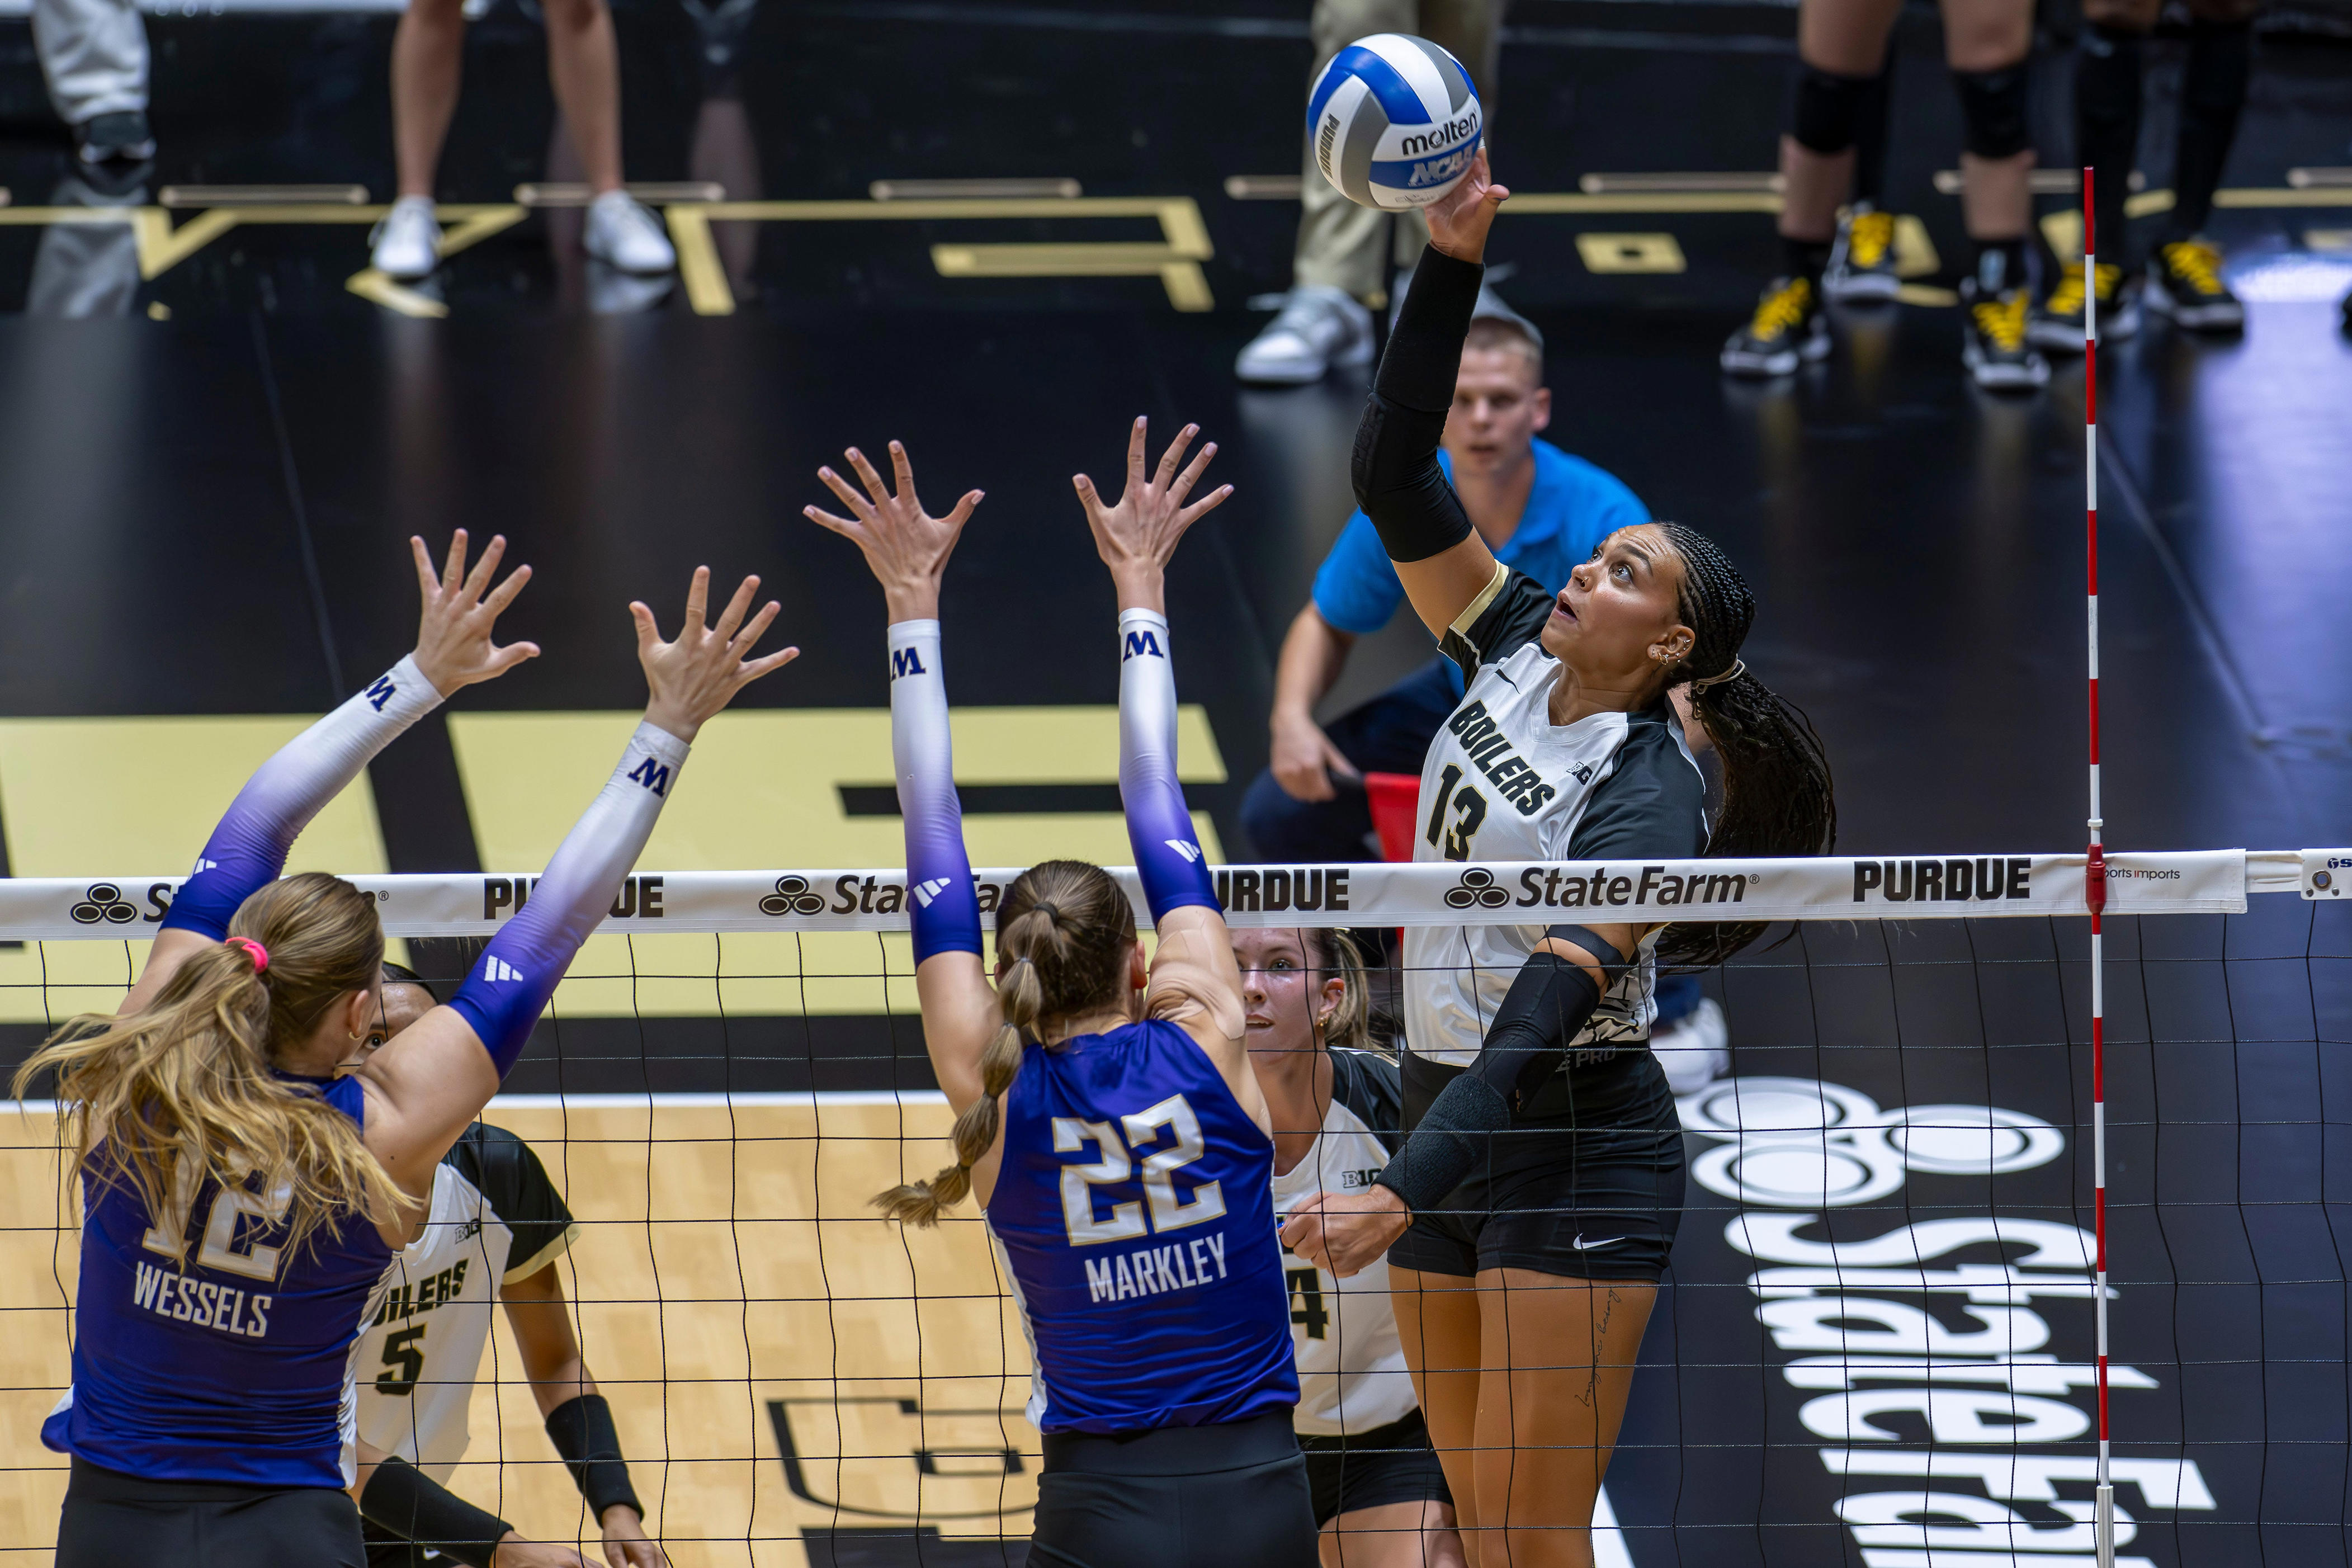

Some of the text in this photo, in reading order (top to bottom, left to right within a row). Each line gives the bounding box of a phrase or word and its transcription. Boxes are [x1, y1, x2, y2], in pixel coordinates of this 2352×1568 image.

[1402, 112, 1477, 156] molten
[1448, 698, 1557, 816] BOILERS
[1426, 762, 1489, 861] 13
[1209, 868, 1349, 911] URDUE
[1853, 858, 2031, 902] PURDUE
[142, 1129, 295, 1282] 12
[1051, 1093, 1227, 1246] 22
[133, 1260, 272, 1338] WESSELS
[371, 1258, 470, 1327] ILERS
[1084, 1231, 1227, 1303] MARKLEY
[375, 1323, 427, 1396] 5
